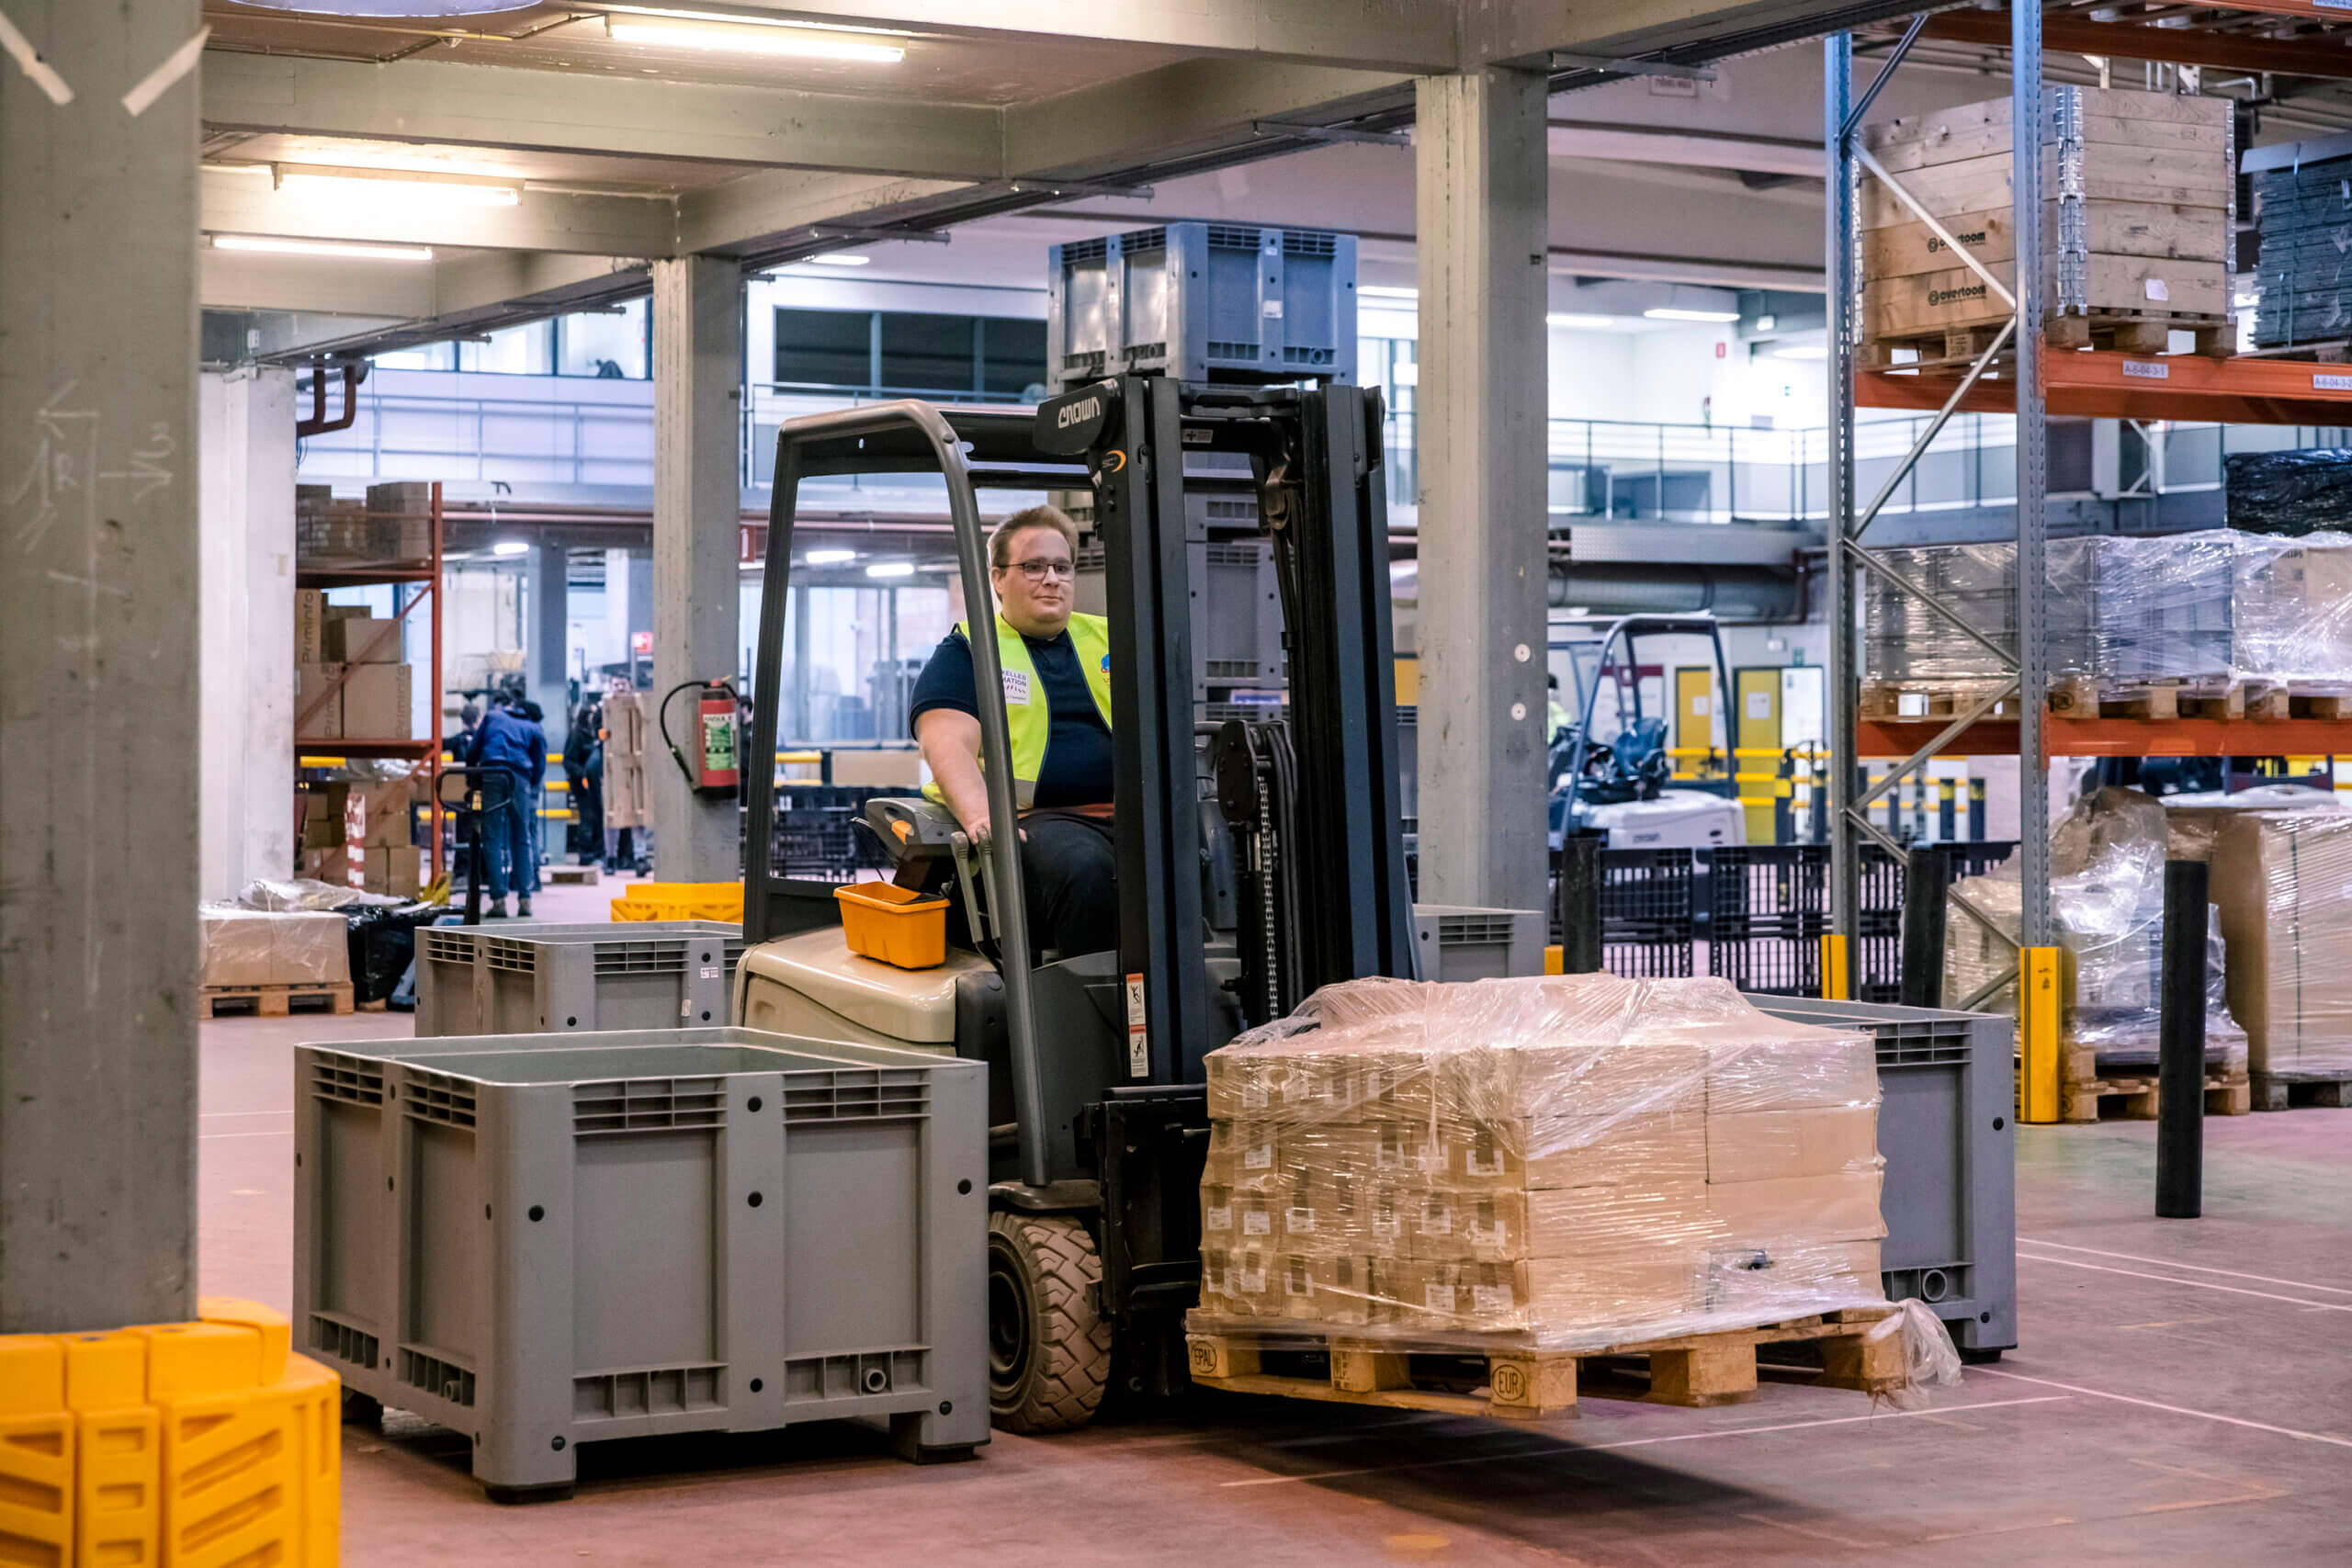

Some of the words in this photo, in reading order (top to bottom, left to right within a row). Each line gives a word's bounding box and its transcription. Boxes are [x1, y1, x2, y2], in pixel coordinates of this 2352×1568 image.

[1939, 231, 1985, 247] otoom
[1939, 285, 1986, 300] overtoom
[1058, 396, 1100, 429] CROWN
[1193, 1348, 1214, 1367] EPAL
[1498, 1371, 1519, 1394] EUR
